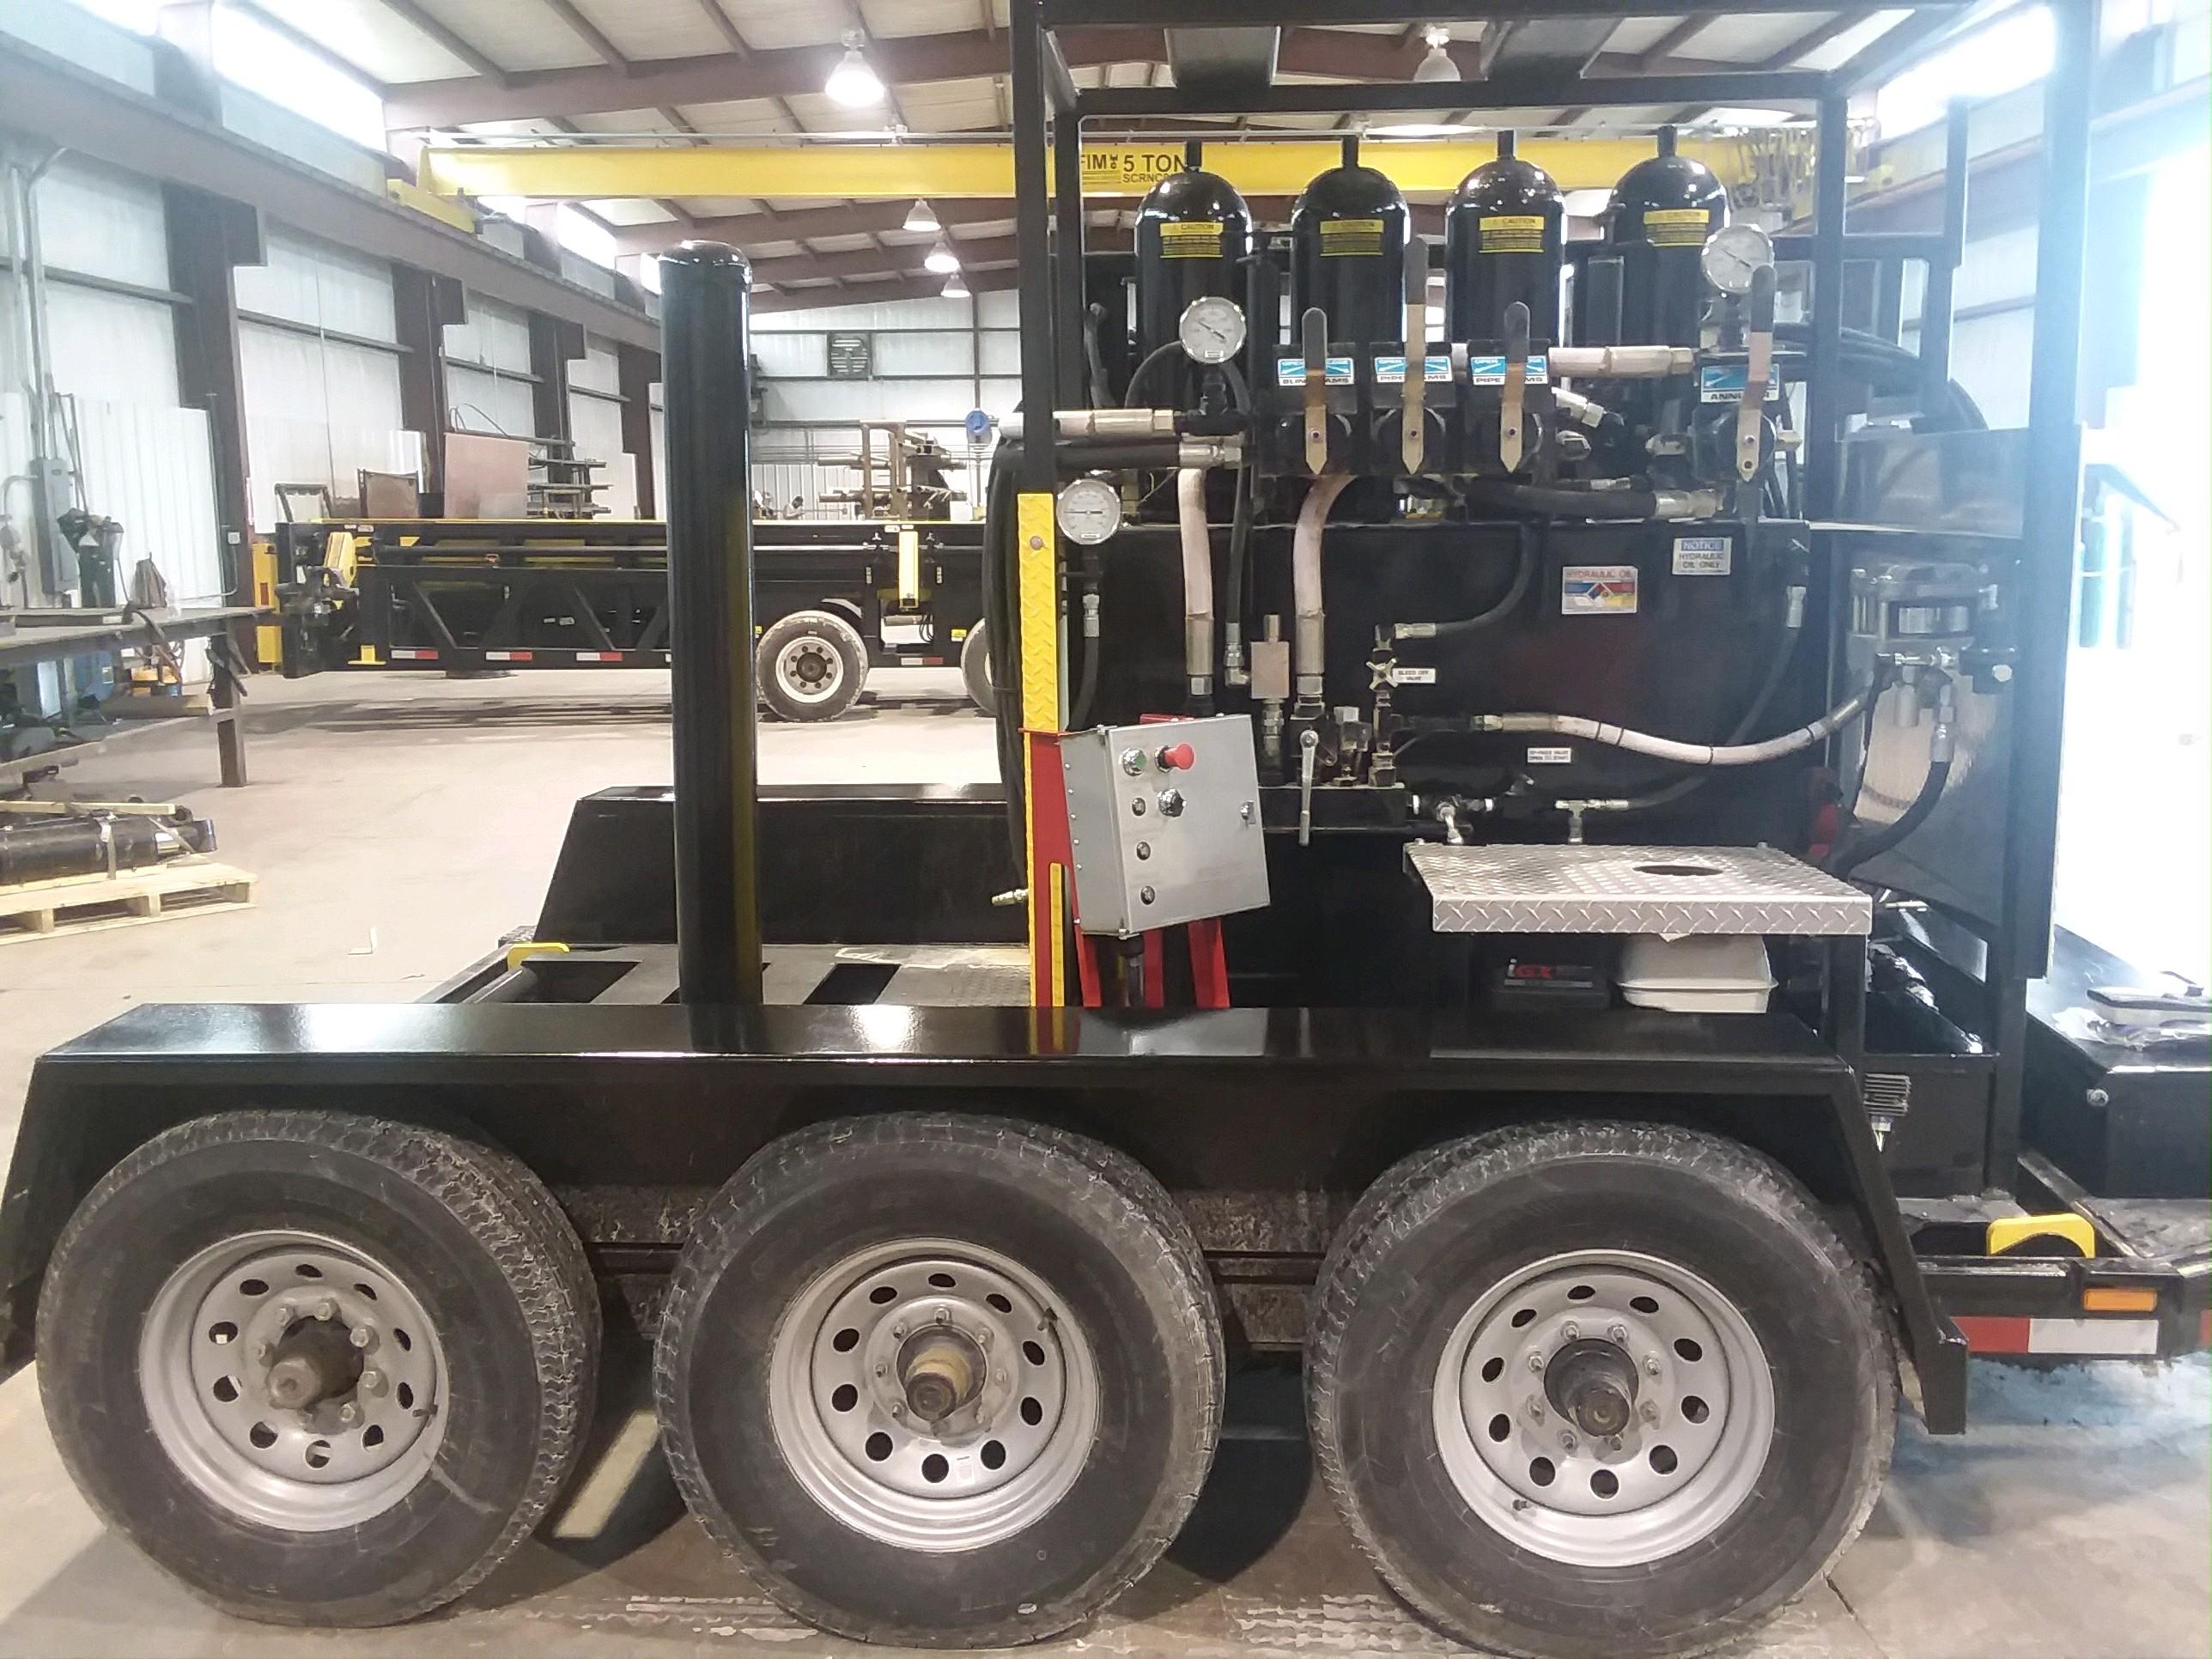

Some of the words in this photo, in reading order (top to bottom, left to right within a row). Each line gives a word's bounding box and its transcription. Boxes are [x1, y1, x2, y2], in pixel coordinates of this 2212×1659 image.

[1123, 155, 1135, 173] 5
[1141, 155, 1187, 173] TON
[1683, 541, 1722, 550] NOTICE
[1565, 569, 1616, 578] HYDRAULIC
